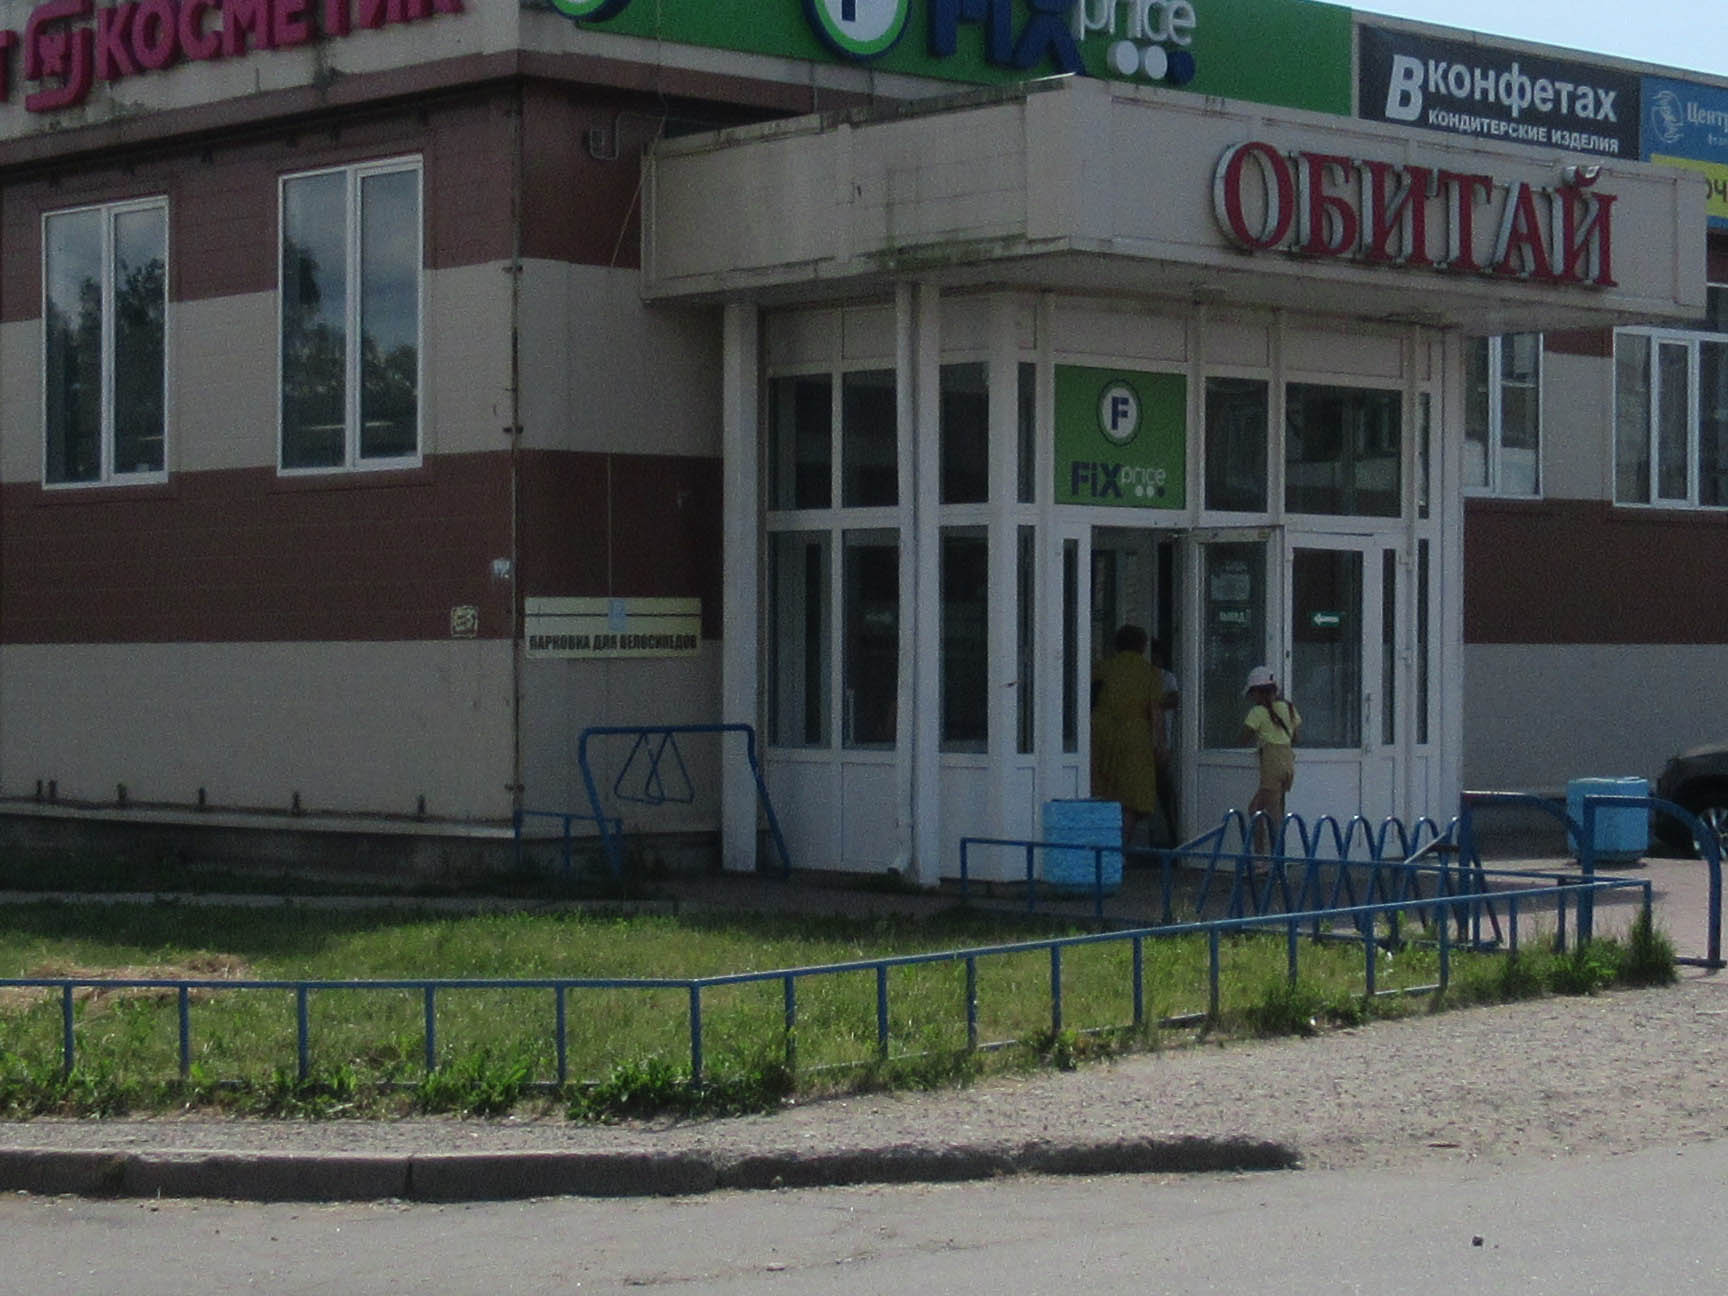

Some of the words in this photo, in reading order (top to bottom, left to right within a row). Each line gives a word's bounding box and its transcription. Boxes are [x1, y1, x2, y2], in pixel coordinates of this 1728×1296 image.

[1429, 108, 1548, 143] КОНДИТЕРСКИЕ
[1551, 129, 1619, 154] ИЗДЕЛИЯ
[1212, 141, 1619, 287] ОБИТАЙ
[528, 634, 590, 651] ПАРКОВКА
[592, 634, 618, 652] ДЛЯ
[620, 633, 698, 651] ВЕЛОСИПЕДОВ
